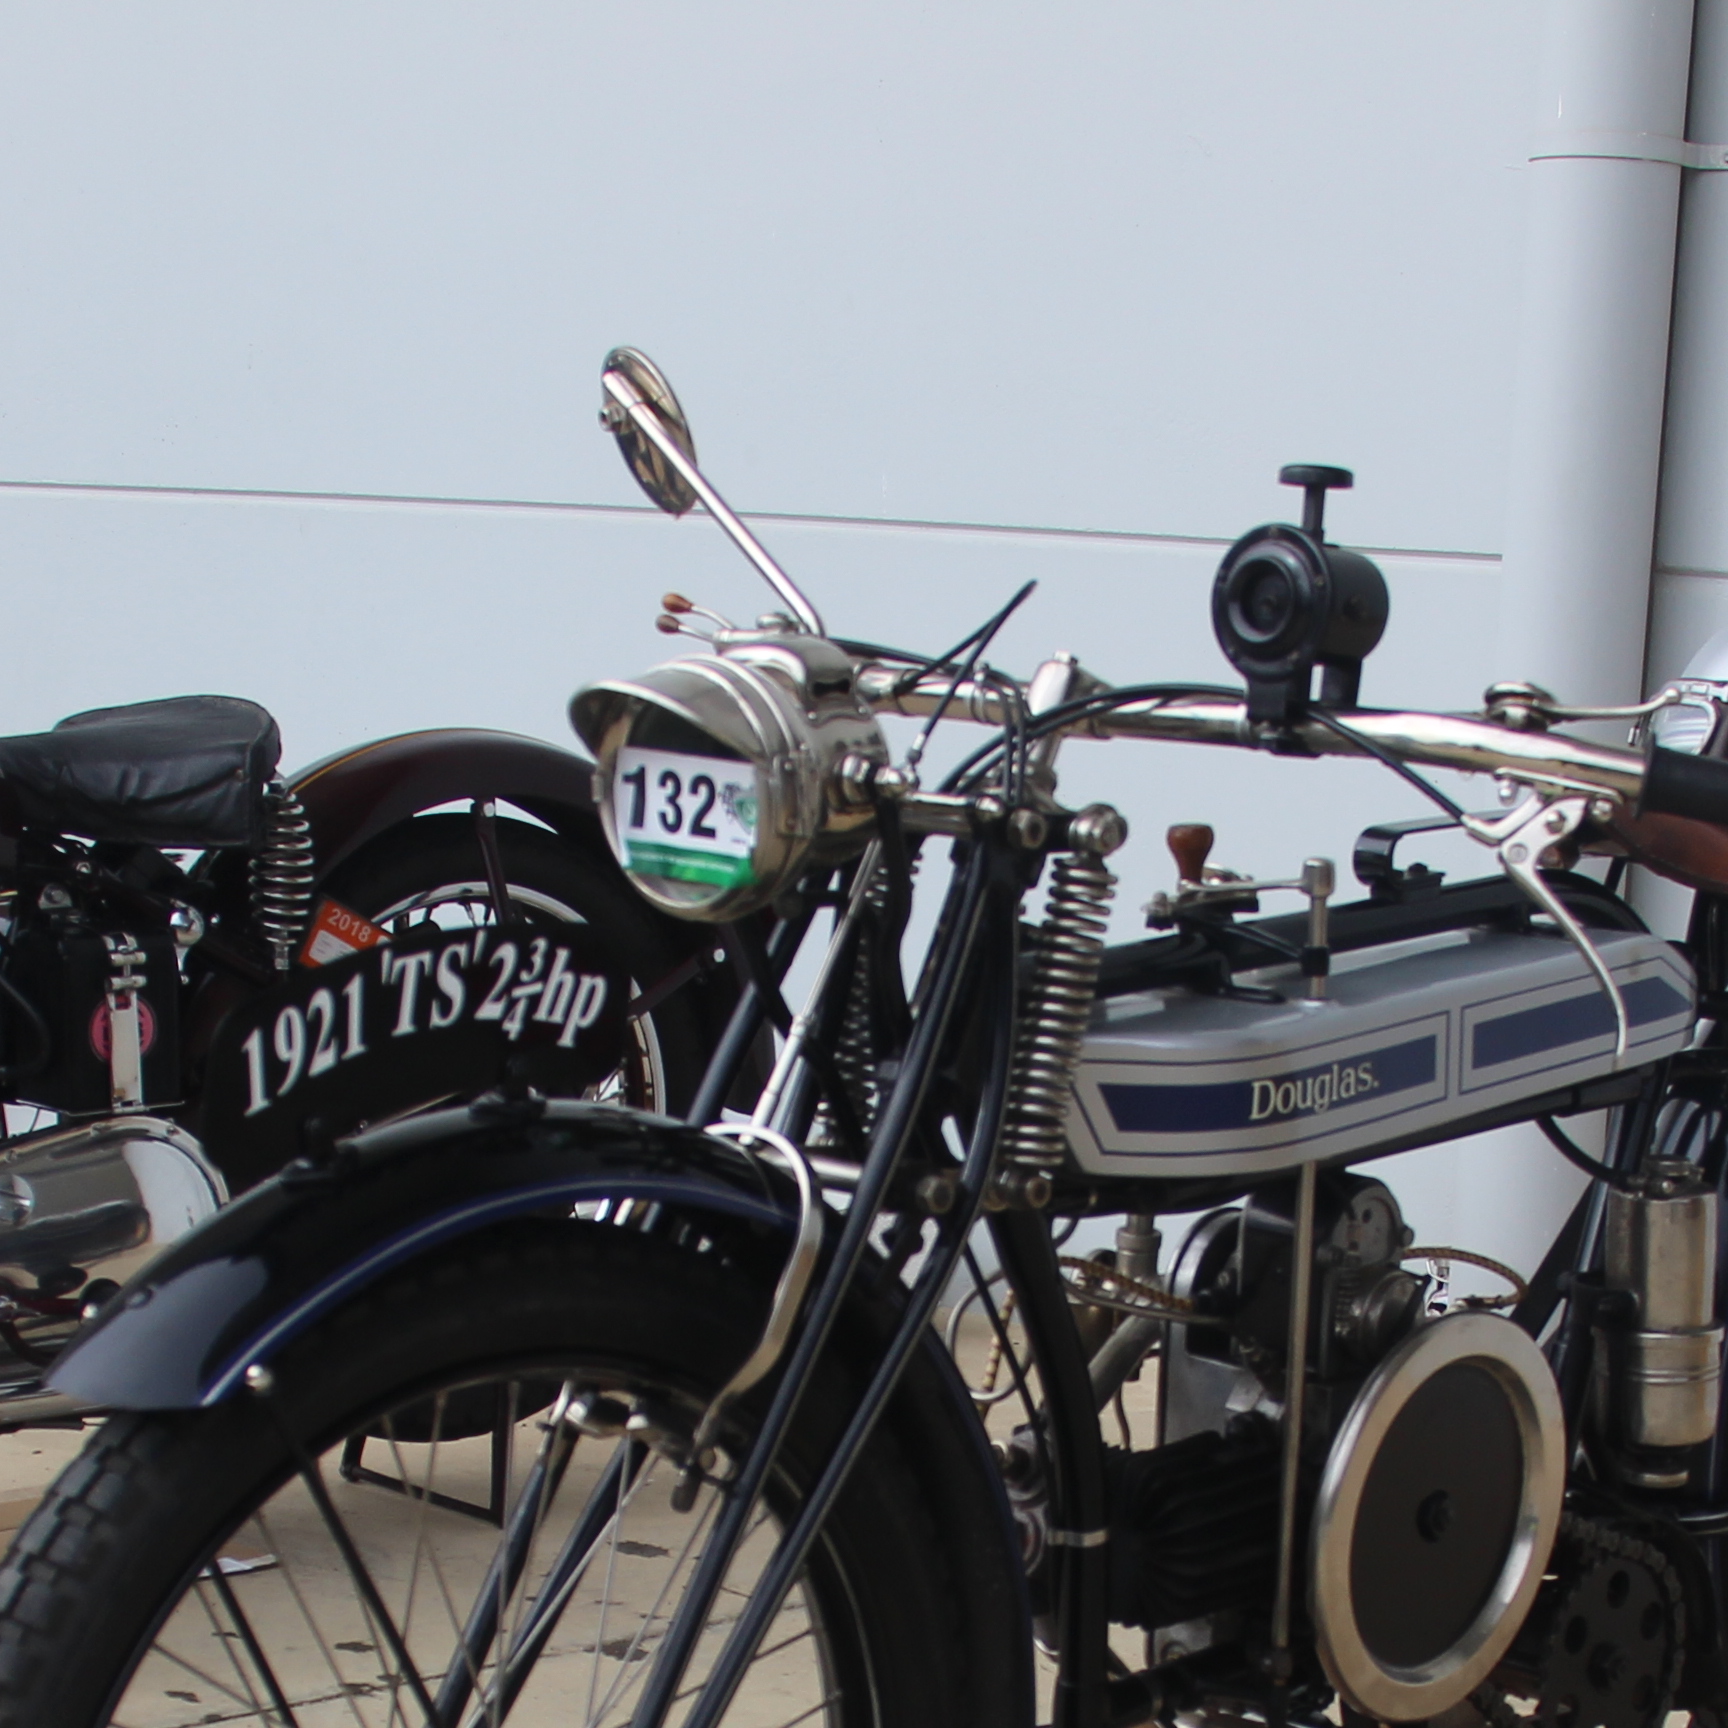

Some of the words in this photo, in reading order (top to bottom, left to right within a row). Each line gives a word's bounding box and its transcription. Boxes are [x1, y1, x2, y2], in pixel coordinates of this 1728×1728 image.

[622, 763, 716, 839] 132
[327, 908, 371, 943] 2018
[240, 972, 368, 1117] 1921
